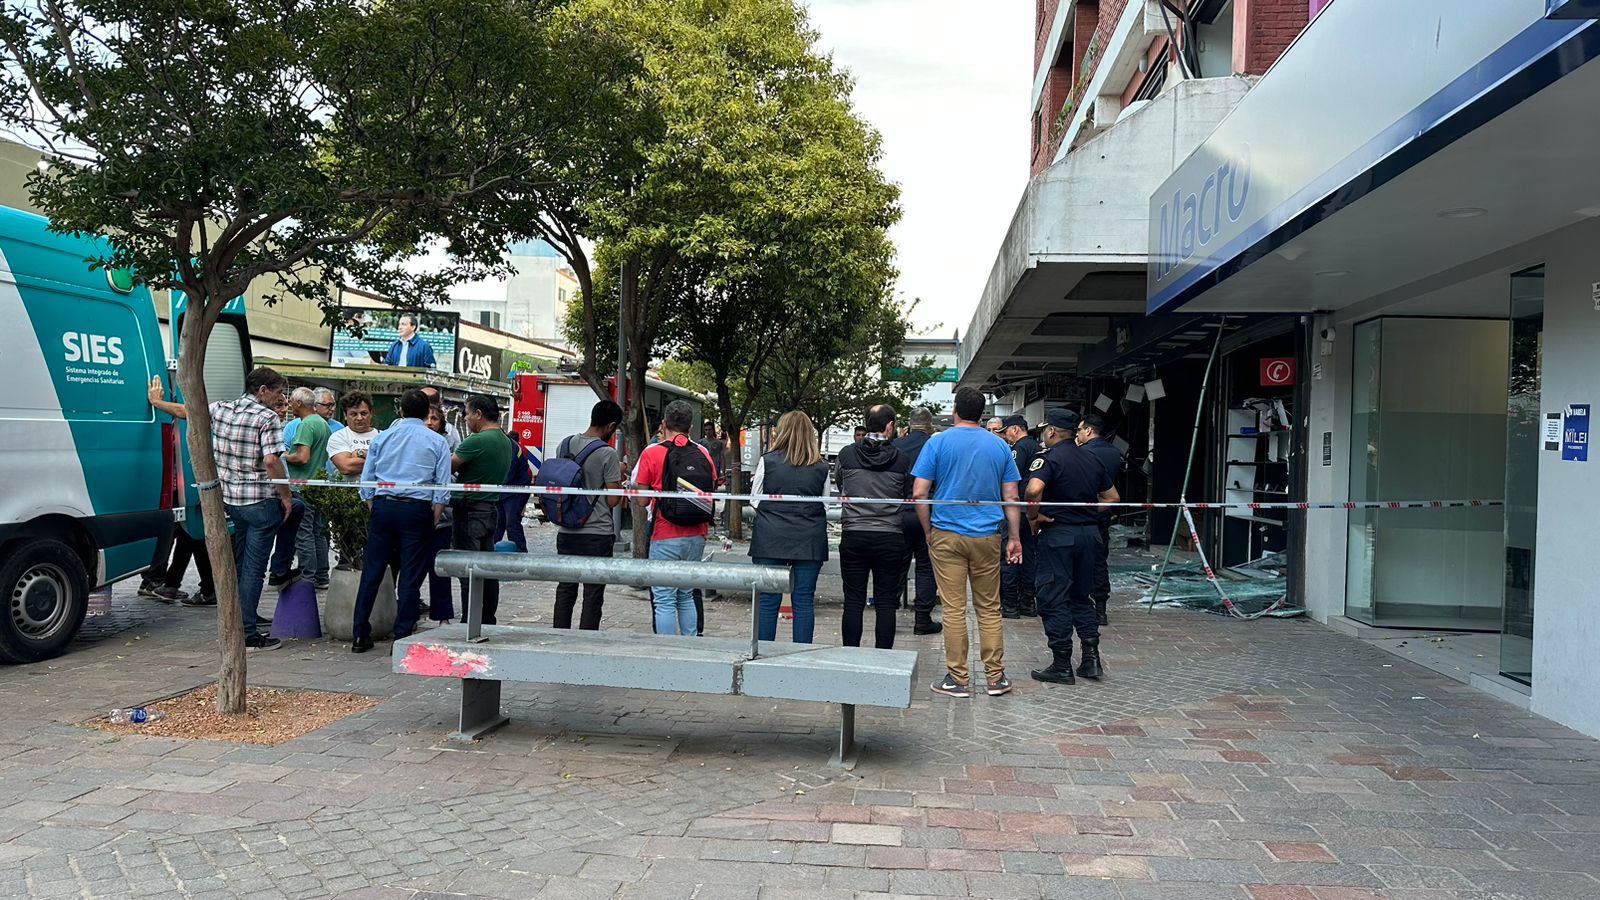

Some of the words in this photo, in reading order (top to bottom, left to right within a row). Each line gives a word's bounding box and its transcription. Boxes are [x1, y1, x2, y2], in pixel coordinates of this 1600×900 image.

[1157, 142, 1251, 281] Macro
[62, 331, 125, 365] SIES
[65, 366, 87, 374] Sistema
[87, 368, 112, 376] Integrado
[66, 375, 100, 384] Emergencias
[100, 377, 125, 385] Sanitarias
[1564, 432, 1587, 443] MILEI
